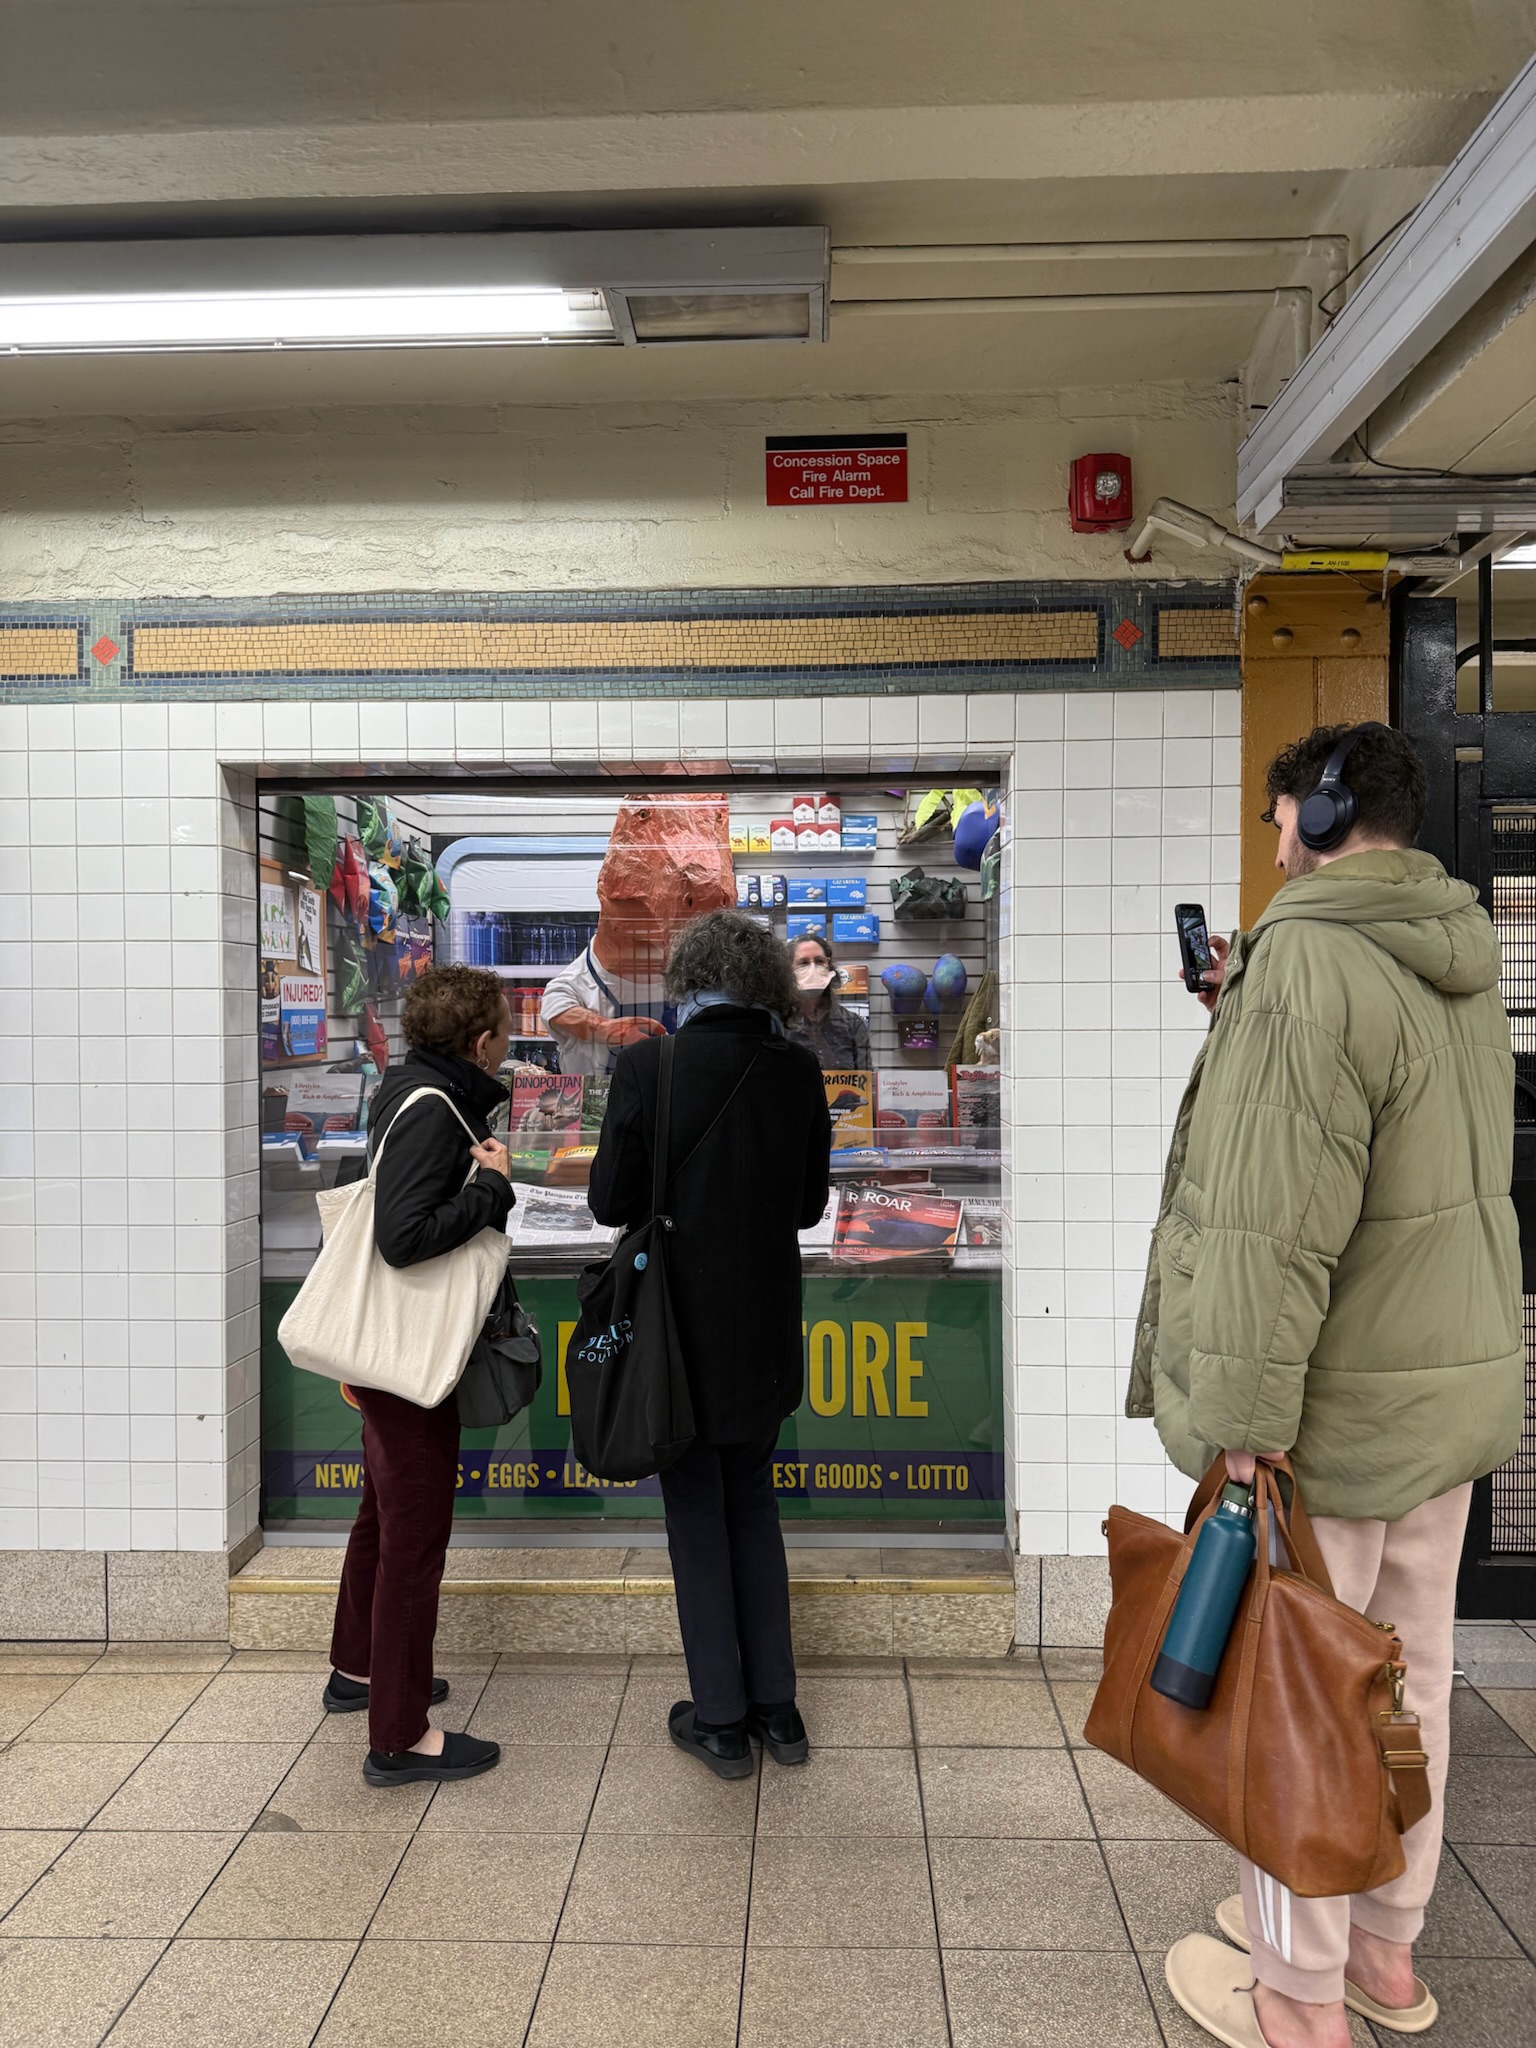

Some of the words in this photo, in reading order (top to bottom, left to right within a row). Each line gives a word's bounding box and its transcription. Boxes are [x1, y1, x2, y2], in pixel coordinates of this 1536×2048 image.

[773, 454, 852, 468] Concession
[857, 453, 900, 467] Space
[802, 470, 827, 483] Fire
[832, 469, 871, 482] Alarm
[789, 486, 814, 499] Call
[819, 485, 844, 498] Fire
[849, 484, 884, 499] Dept.
[283, 983, 323, 1003] INJURED?
[515, 1076, 582, 1089] DINOPOLITAN
[822, 1075, 868, 1091] RASHER
[864, 1191, 912, 1213] ROAR
[802, 1320, 929, 1417] ORE
[488, 1463, 540, 1489] EGGS
[772, 1463, 809, 1489] EST
[815, 1463, 883, 1490] GOODS
[907, 1465, 969, 1491] LOTTO
